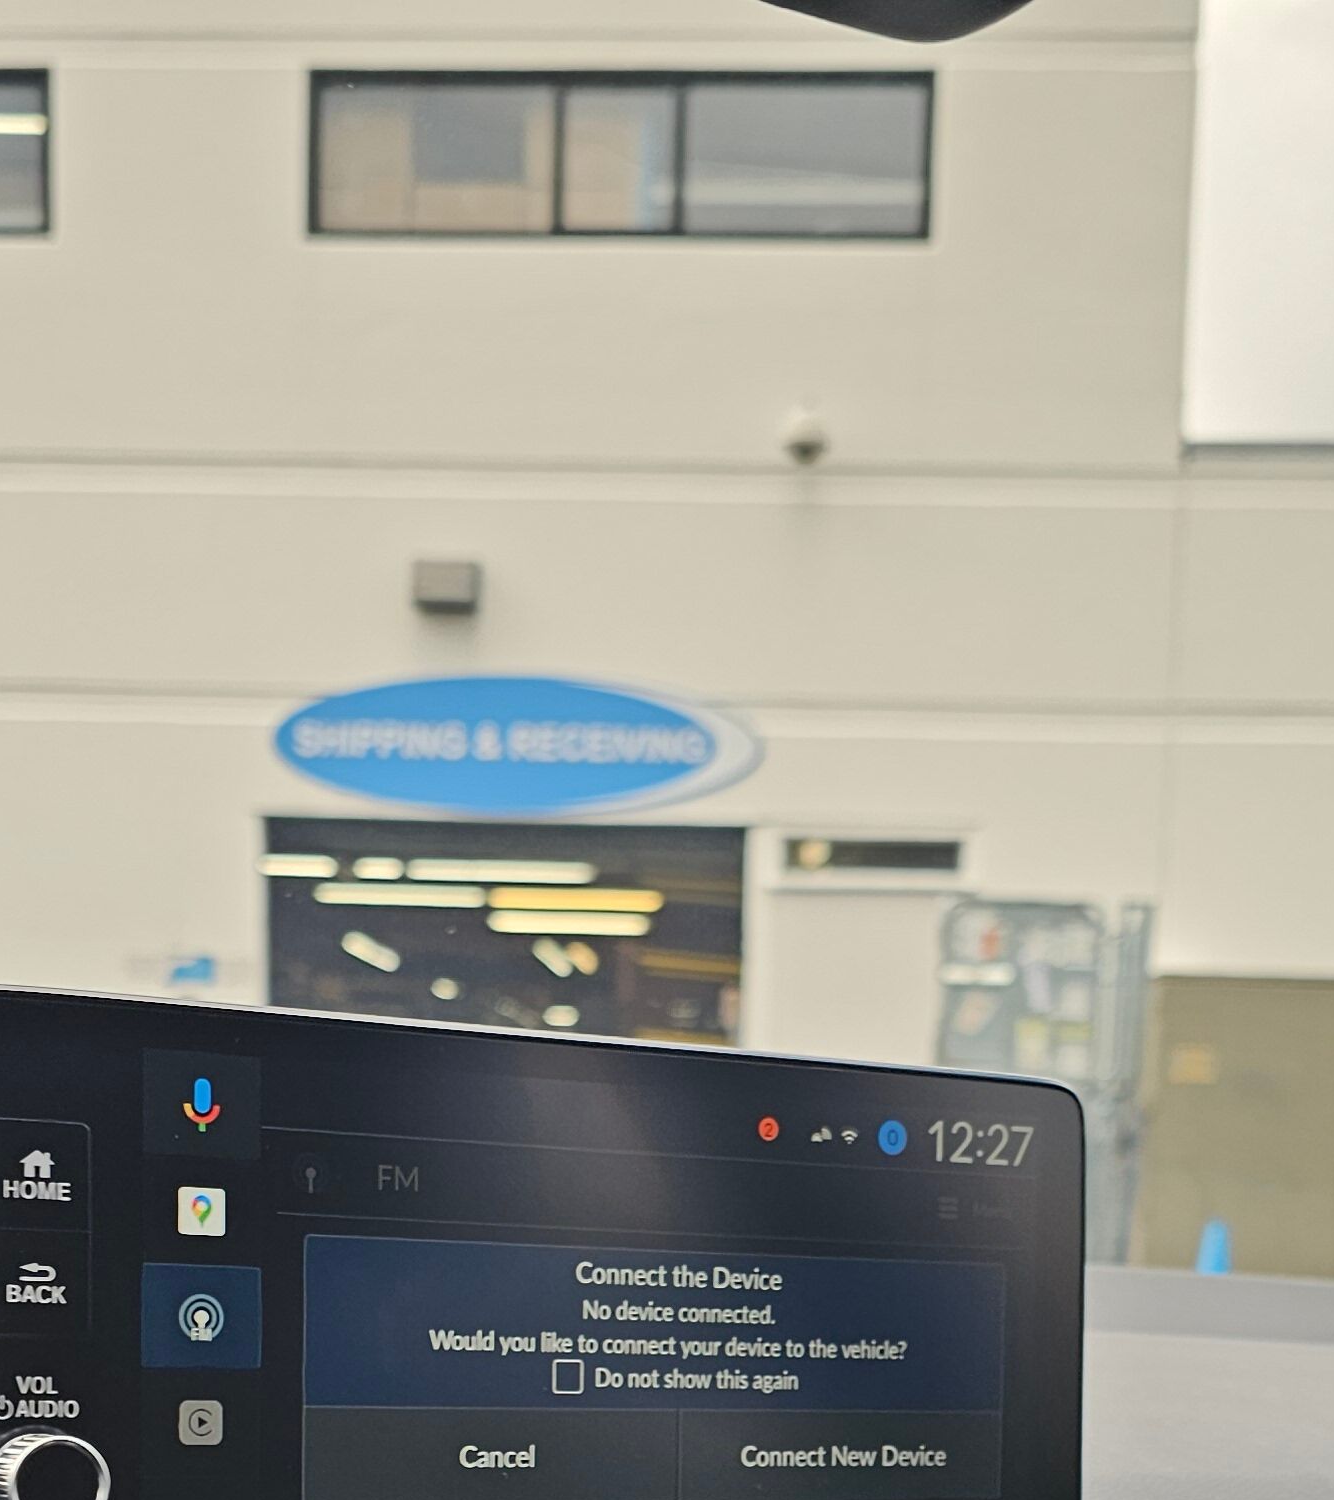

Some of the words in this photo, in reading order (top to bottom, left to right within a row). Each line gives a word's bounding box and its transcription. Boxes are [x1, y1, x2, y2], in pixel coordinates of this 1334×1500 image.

[928, 1120, 1034, 1167] 12:27
[2, 1179, 72, 1201] HOME
[378, 1165, 420, 1193] FM
[575, 1261, 667, 1287] Connect
[672, 1264, 708, 1288] the
[713, 1266, 783, 1290] Device
[5, 1284, 67, 1304] BACK
[582, 1300, 611, 1320] No
[615, 1300, 674, 1322] device
[678, 1304, 776, 1325] connected.
[429, 1329, 495, 1351] Would
[499, 1336, 535, 1356] you
[540, 1331, 573, 1353] like
[578, 1334, 598, 1354] to
[602, 1336, 676, 1356] connect
[680, 1340, 722, 1360] your
[725, 1337, 782, 1358] device
[785, 1339, 805, 1358] to
[809, 1339, 838, 1359] the
[841, 1340, 908, 1360] vehicle?
[16, 1376, 59, 1394] VOL
[595, 1367, 623, 1388] Do
[628, 1369, 660, 1389] not
[664, 1368, 711, 1390] show
[716, 1369, 748, 1390] this
[752, 1370, 799, 1394] again
[15, 1400, 80, 1418] AUDIO
[459, 1445, 536, 1468] Cancel
[740, 1445, 826, 1467] Connect
[831, 1445, 877, 1467] New
[881, 1445, 947, 1467] Device
